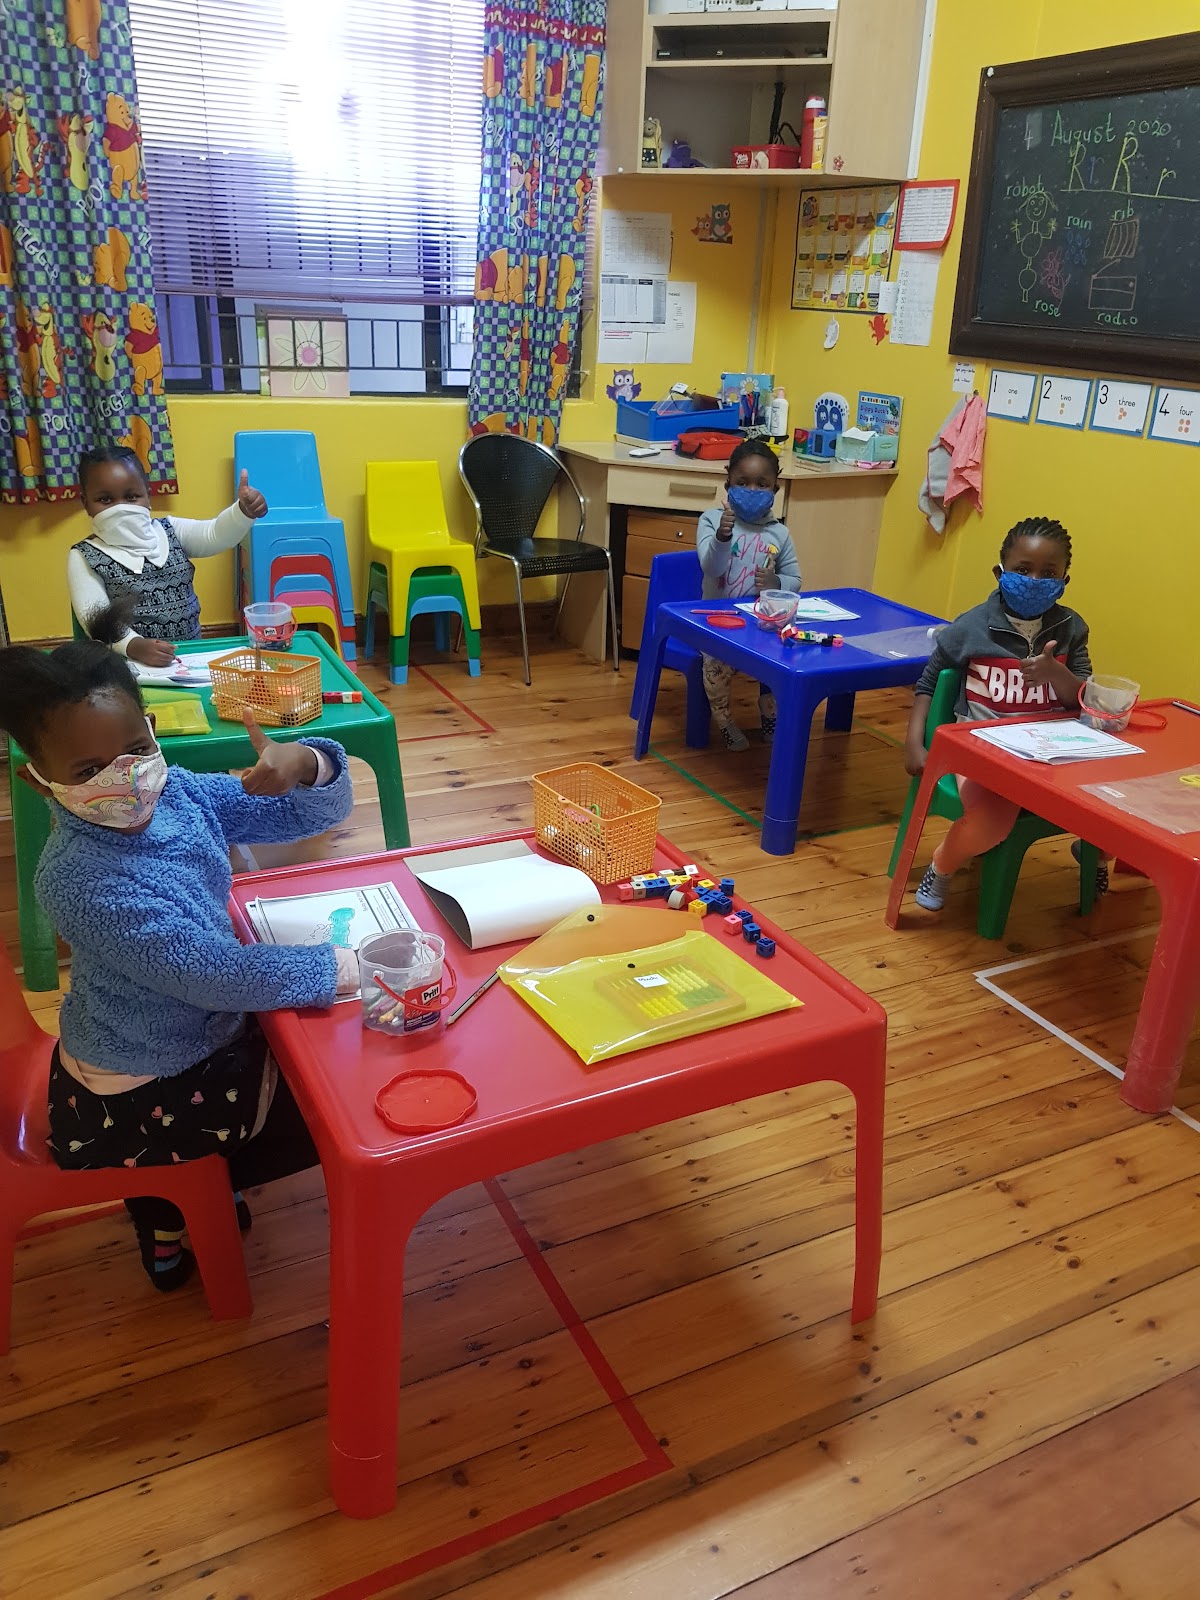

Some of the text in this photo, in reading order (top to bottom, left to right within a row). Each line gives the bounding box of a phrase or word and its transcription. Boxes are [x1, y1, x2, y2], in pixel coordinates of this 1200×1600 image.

[1024, 110, 1172, 157] 4 August 2020
[1068, 141, 1087, 190] R
[1112, 136, 1139, 193] R
[1156, 167, 1177, 196] r
[1006, 174, 1046, 197] robot
[1114, 199, 1134, 220] rib
[1066, 214, 1093, 231] rain
[1034, 299, 1061, 317] rose
[1096, 311, 1138, 326] radio
[993, 374, 998, 393] 1
[1042, 380, 1053, 400] 2
[1060, 394, 1072, 402] two
[1099, 384, 1109, 405] 3
[1118, 398, 1136, 408] three
[94, 389, 129, 420] IGGE
[1158, 393, 1170, 417] 4
[1179, 405, 1194, 417] four
[423, 986, 439, 1001] Pritt
